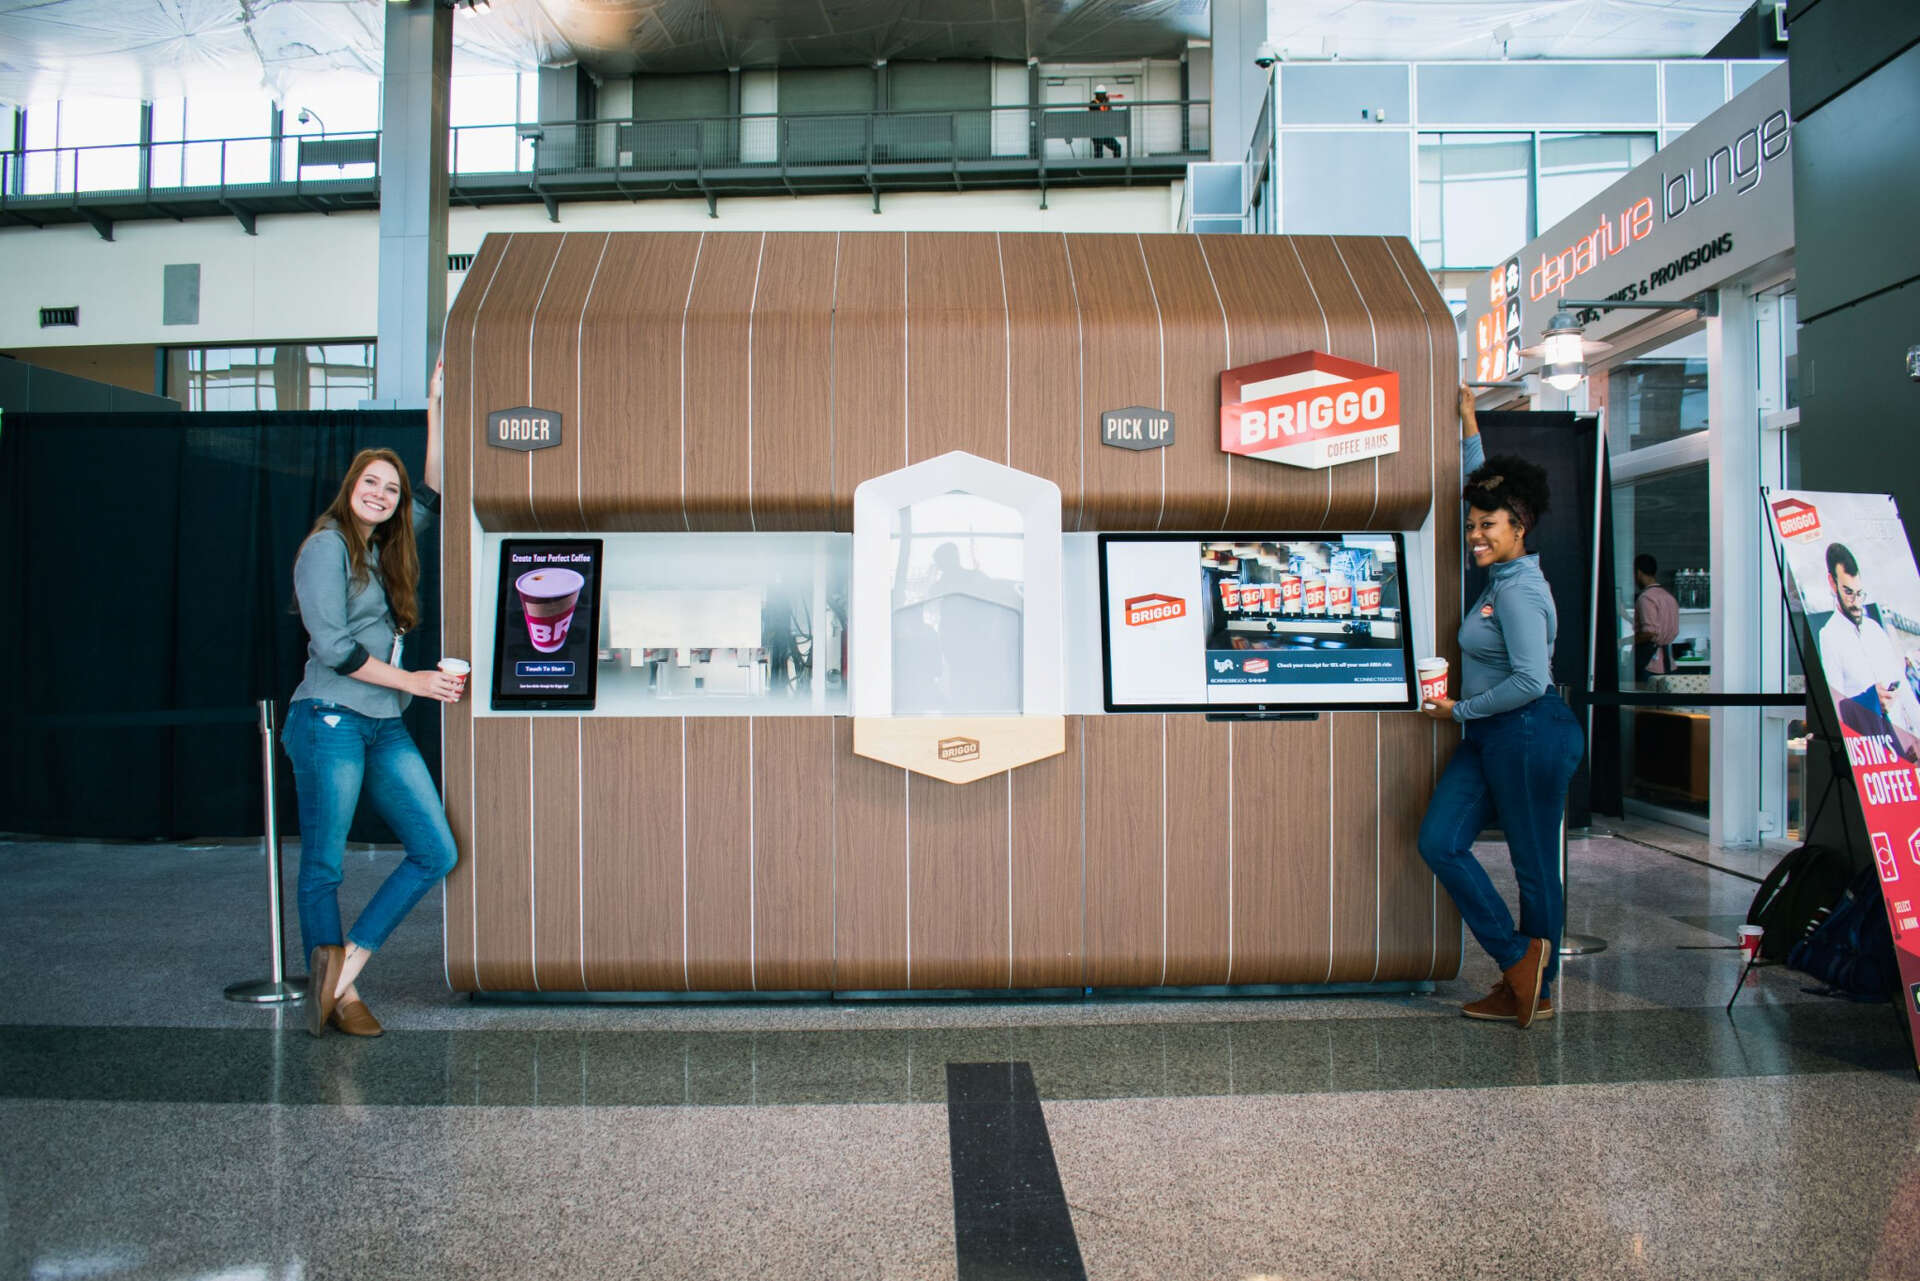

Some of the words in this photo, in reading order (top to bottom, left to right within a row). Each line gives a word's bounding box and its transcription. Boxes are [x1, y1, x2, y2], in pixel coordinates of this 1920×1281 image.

[1530, 197, 1653, 301] departure
[1662, 109, 1791, 224] lounge
[1638, 279, 1649, 297] &
[1650, 232, 1733, 290] PROVISIONS
[1240, 386, 1386, 446] BRIGGO
[499, 418, 550, 440] ORDER
[1107, 418, 1143, 440] PICK
[1148, 418, 1169, 440] UP
[1327, 439, 1361, 458] COFFEE
[1364, 433, 1389, 451] HAUS
[1780, 512, 1817, 534] BRIGGO
[512, 553, 532, 562] Create
[533, 553, 547, 562] Your
[547, 553, 570, 562] Perfect
[570, 553, 591, 562] Coffee
[1131, 603, 1181, 624] BRIGGO
[942, 744, 977, 758] BRIGGO
[1843, 734, 1898, 767] USTIN'S
[1862, 769, 1918, 805] COFFEE
[1894, 900, 1911, 913] SELECT
